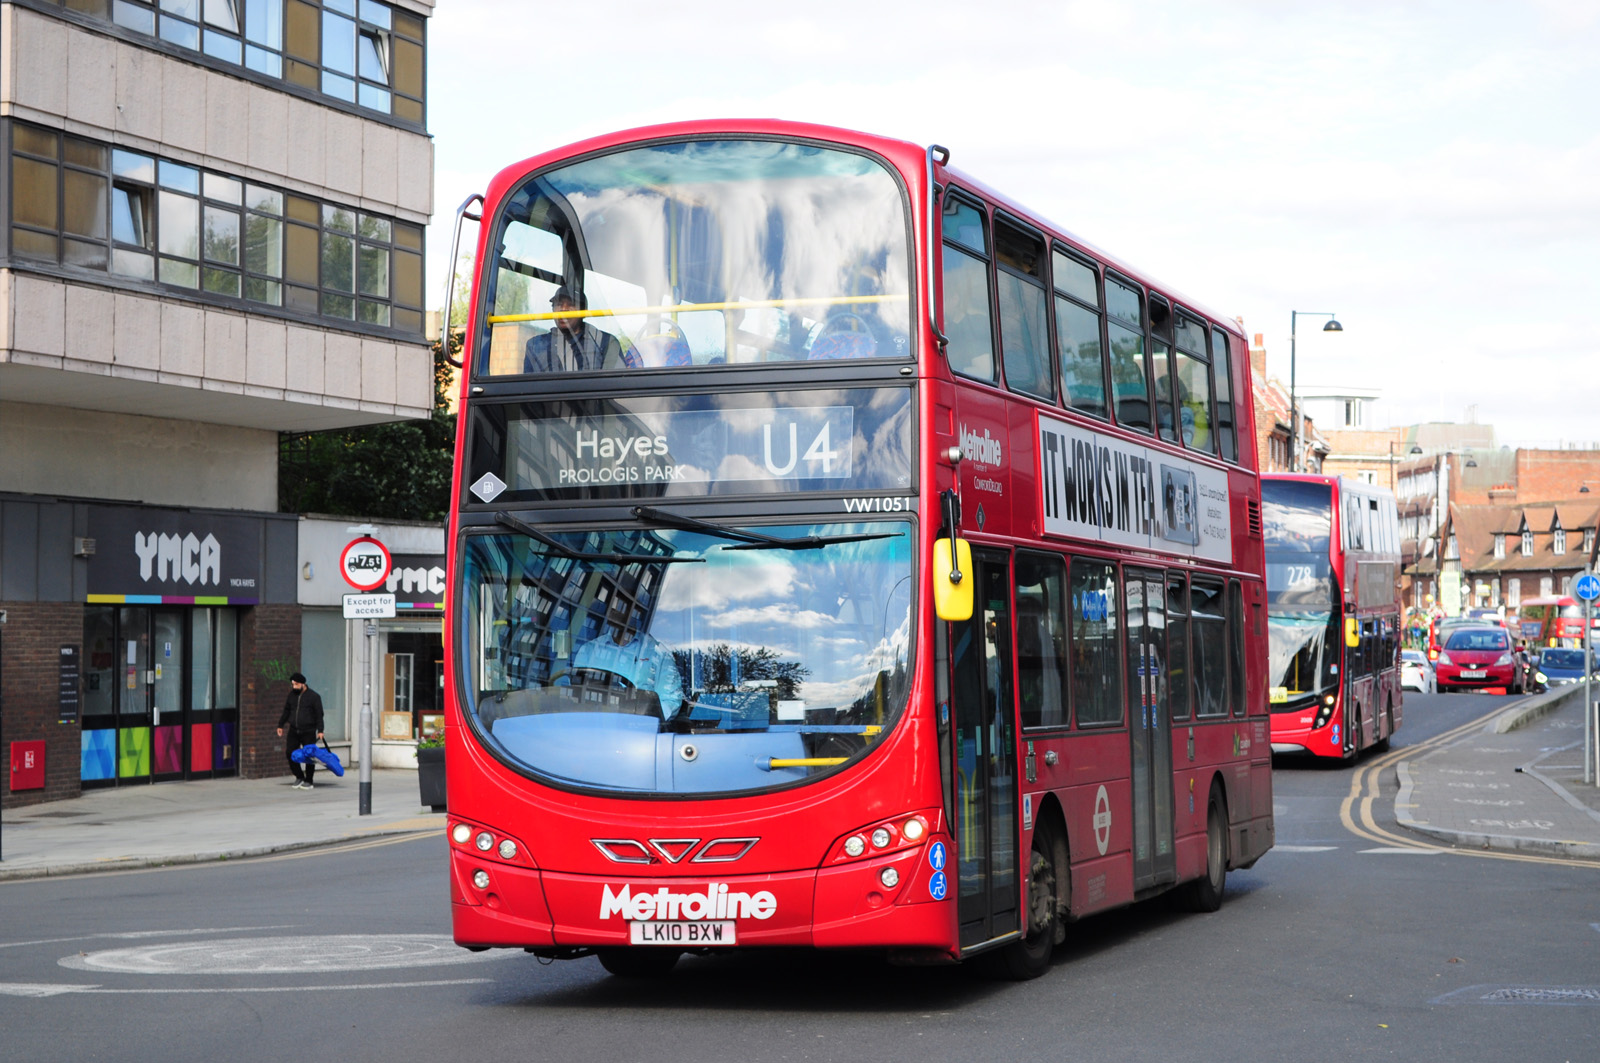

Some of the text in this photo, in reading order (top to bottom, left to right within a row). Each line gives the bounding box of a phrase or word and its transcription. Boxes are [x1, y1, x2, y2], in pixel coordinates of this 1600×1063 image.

[576, 430, 669, 465] Hayes
[763, 421, 838, 475] U4
[960, 421, 1001, 467] Metroline
[559, 464, 686, 484] PROLOGIS PARK
[1042, 430, 1058, 519] IT
[1061, 434, 1113, 529] WORKS
[1114, 450, 1130, 532] IN
[843, 496, 911, 513] VW1051
[135, 530, 221, 586] YMCA
[1287, 566, 1311, 587] 278
[347, 598, 376, 607] Except
[599, 883, 777, 921] Metroline
[642, 923, 723, 941] LK10 BXW
